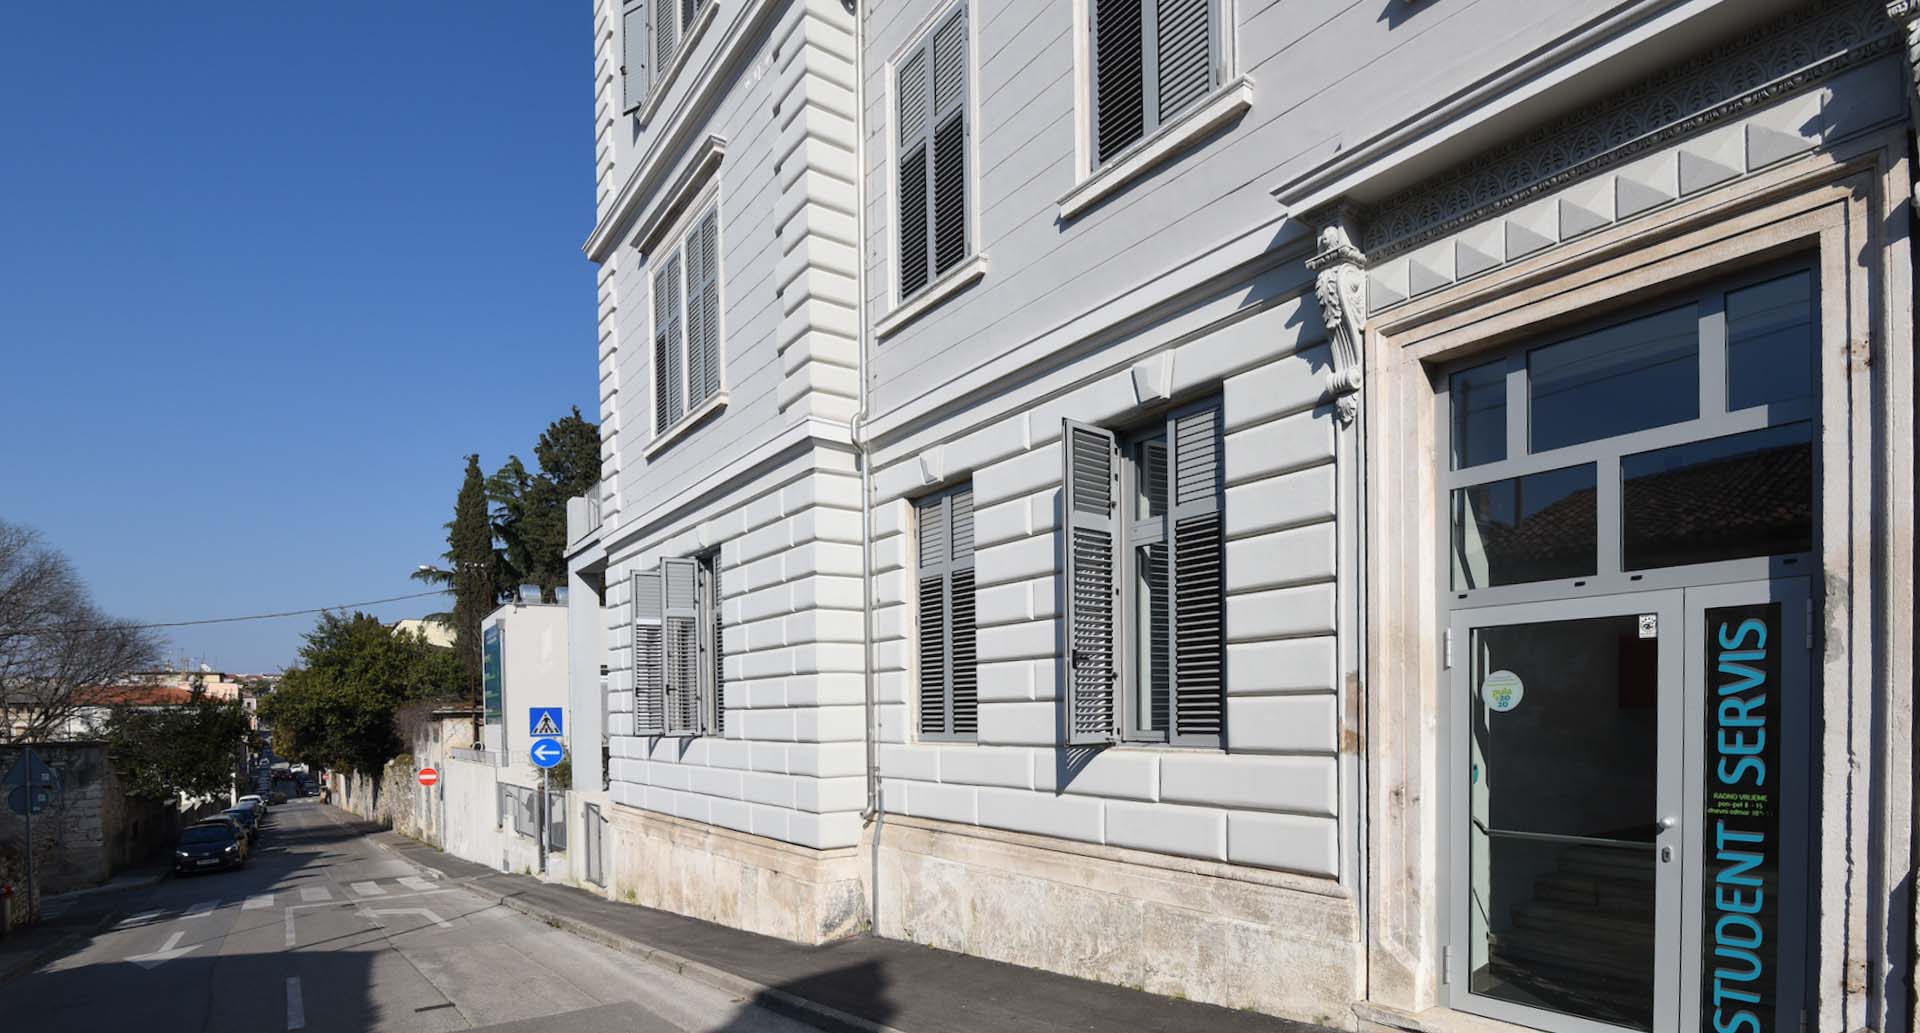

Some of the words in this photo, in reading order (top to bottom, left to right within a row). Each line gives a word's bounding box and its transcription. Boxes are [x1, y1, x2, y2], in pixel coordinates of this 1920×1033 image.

[1717, 618, 1768, 786] SERVIS
[1713, 792, 1738, 800] RADNO
[1739, 793, 1768, 801] VRIJEME
[1713, 820, 1765, 1033] STUDENT
